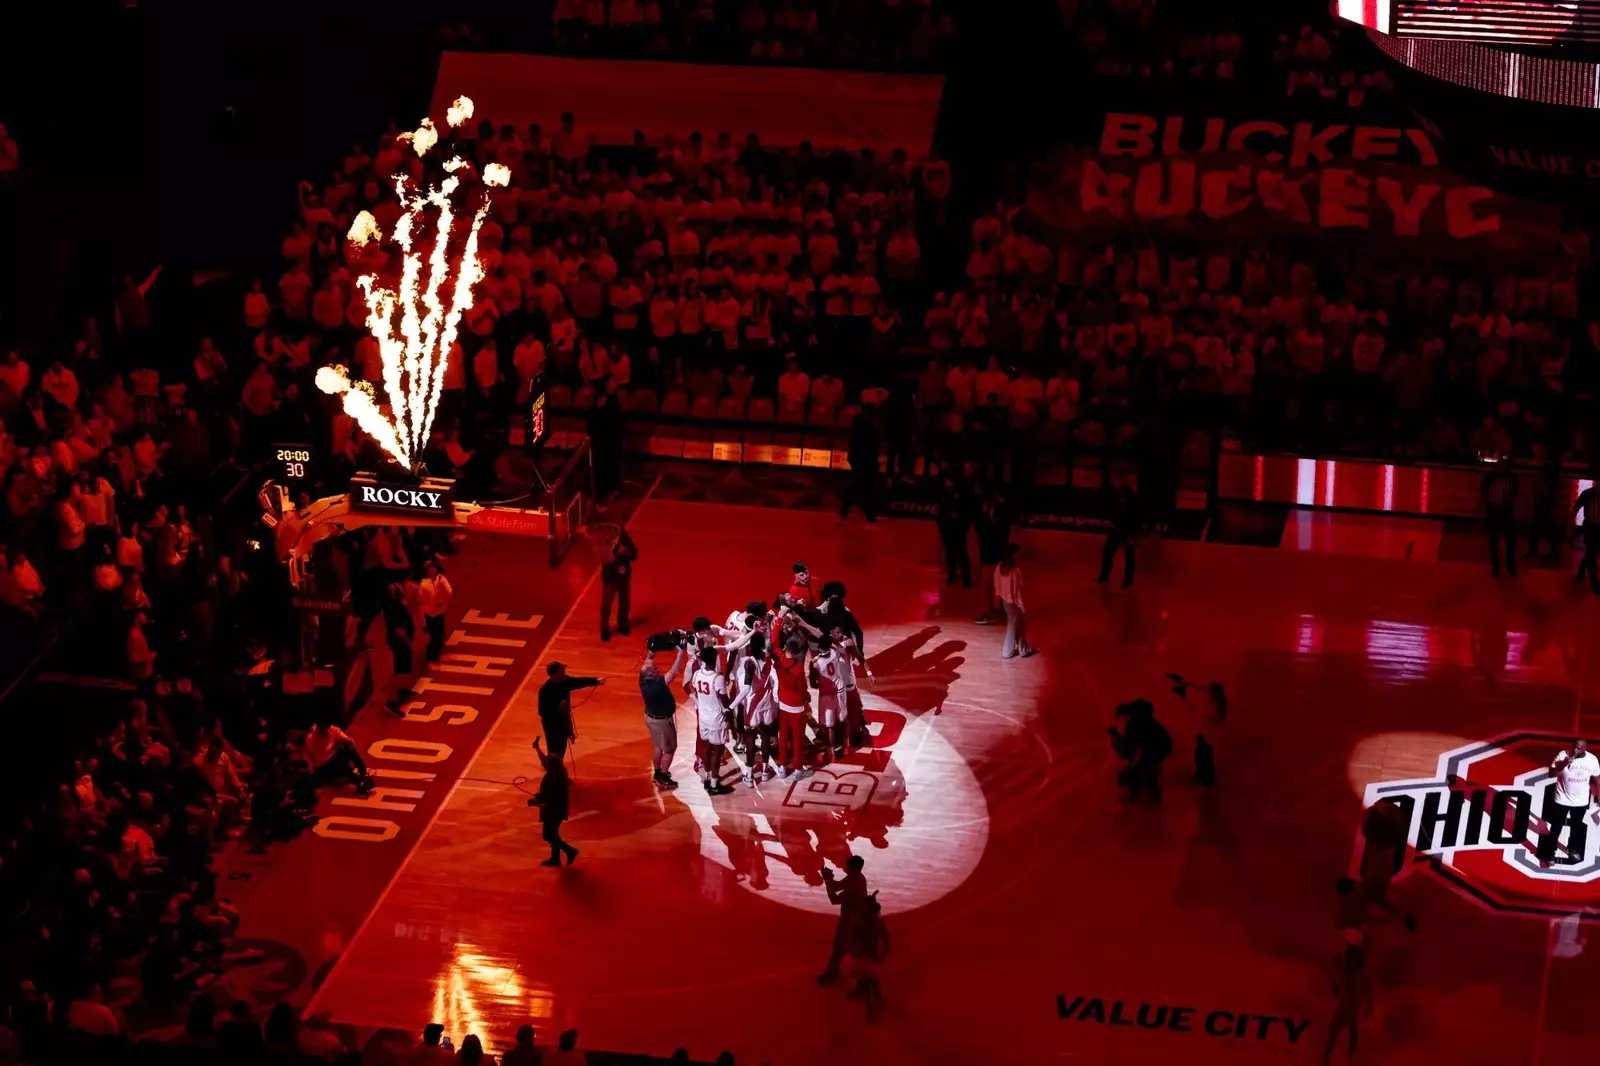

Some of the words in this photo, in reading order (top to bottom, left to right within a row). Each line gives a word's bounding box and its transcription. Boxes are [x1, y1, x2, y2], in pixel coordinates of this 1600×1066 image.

[1488, 144, 1579, 176] VALUE
[277, 449, 310, 462] 20:00
[286, 462, 304, 477] 30
[827, 663, 835, 676] 0
[697, 680, 710, 696] 13
[312, 738, 454, 843] OHIO
[402, 608, 545, 726] STATE
[1056, 994, 1198, 1032] VALUE
[1205, 1010, 1311, 1045] CITY
